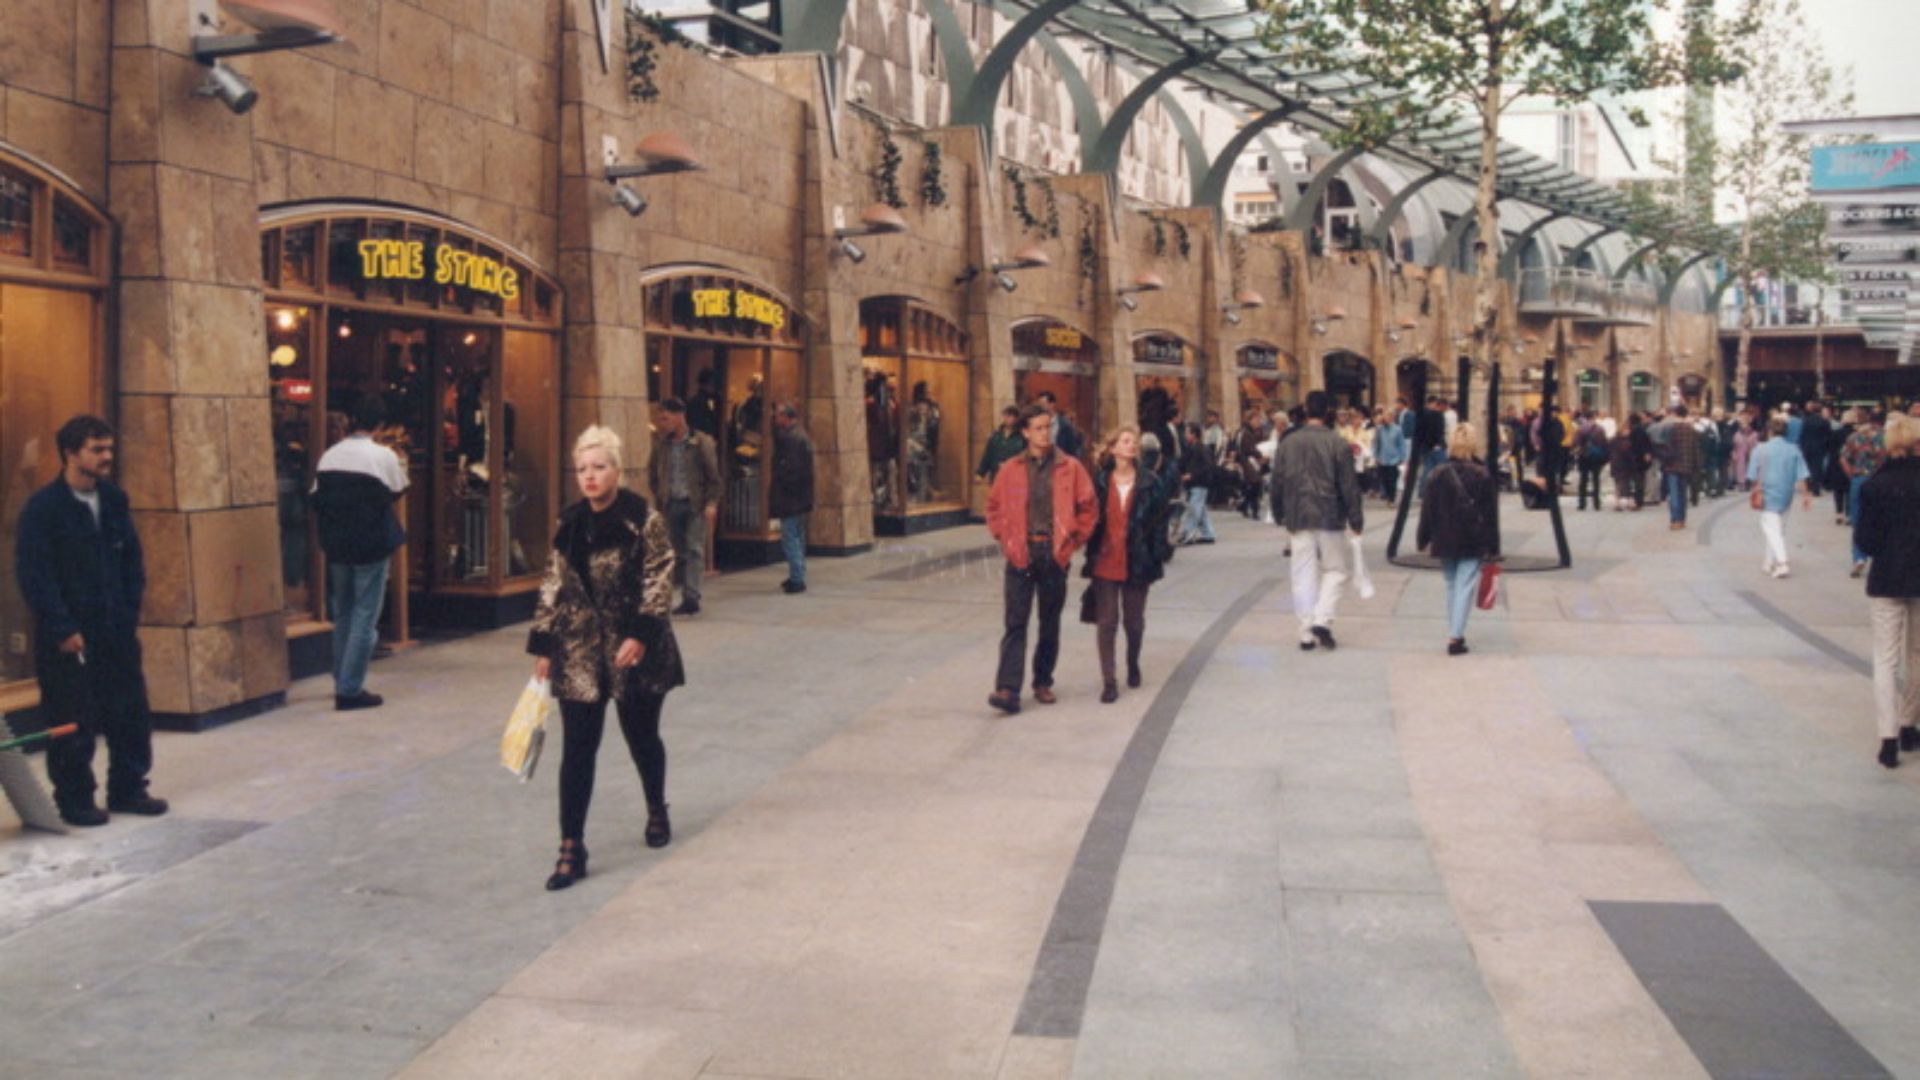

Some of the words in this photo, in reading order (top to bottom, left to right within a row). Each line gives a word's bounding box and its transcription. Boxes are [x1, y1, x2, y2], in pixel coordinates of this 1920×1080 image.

[358, 240, 424, 279] THE
[435, 244, 519, 299] STING
[692, 288, 730, 316] THE
[735, 290, 784, 328] STING
